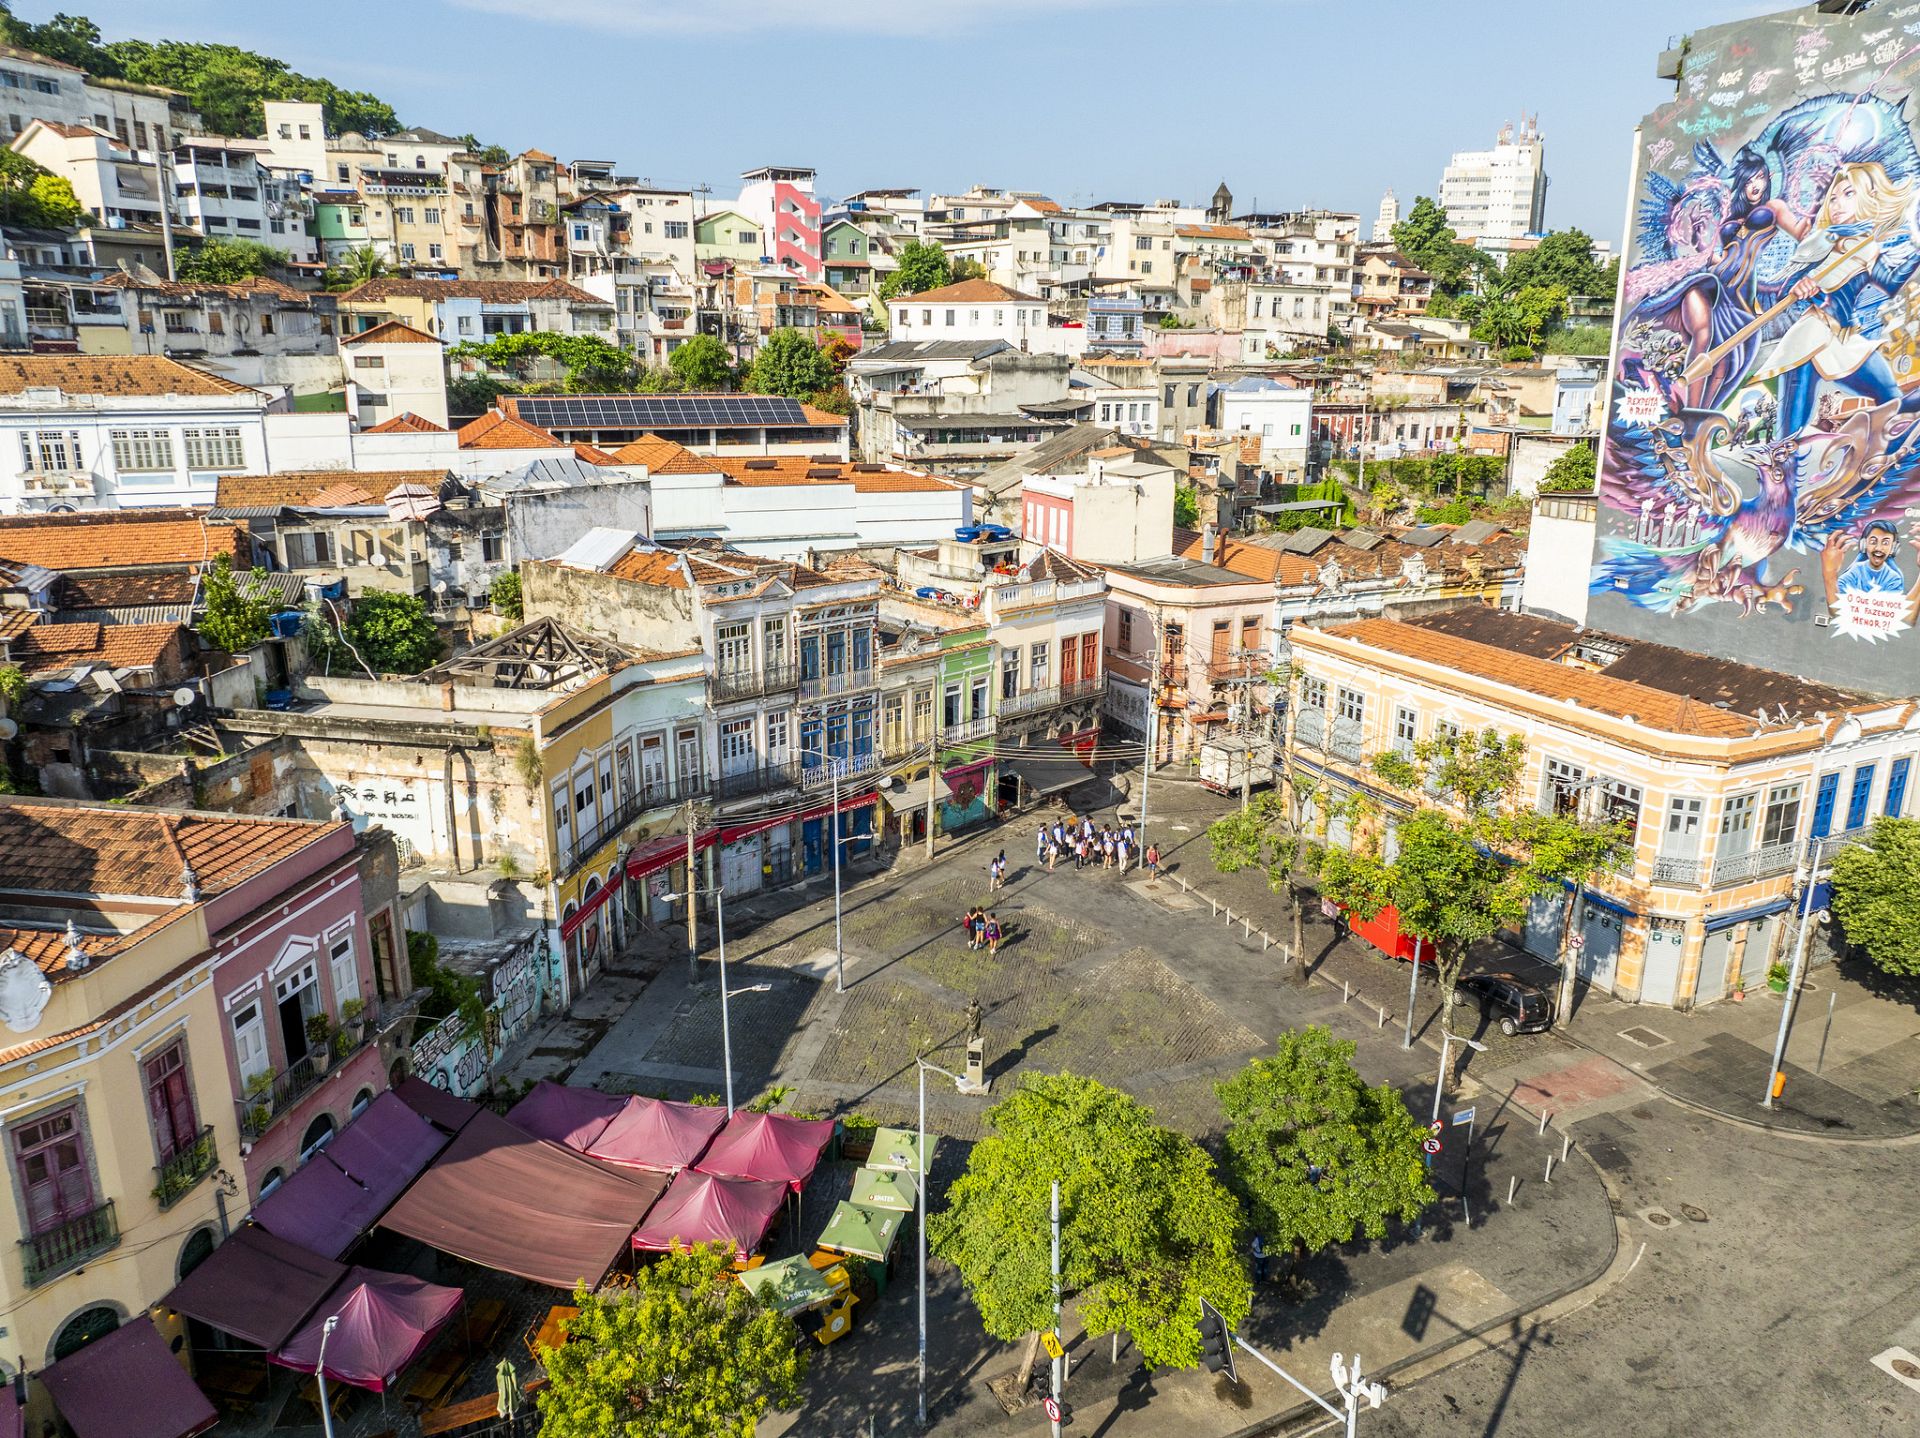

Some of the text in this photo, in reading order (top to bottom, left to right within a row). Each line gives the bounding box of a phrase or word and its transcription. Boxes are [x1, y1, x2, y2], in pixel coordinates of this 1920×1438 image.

[1847, 594, 1853, 602] O
[1856, 595, 1869, 604] QUE
[1872, 598, 1884, 607] QUE
[1864, 607, 1895, 618] FAZENDO
